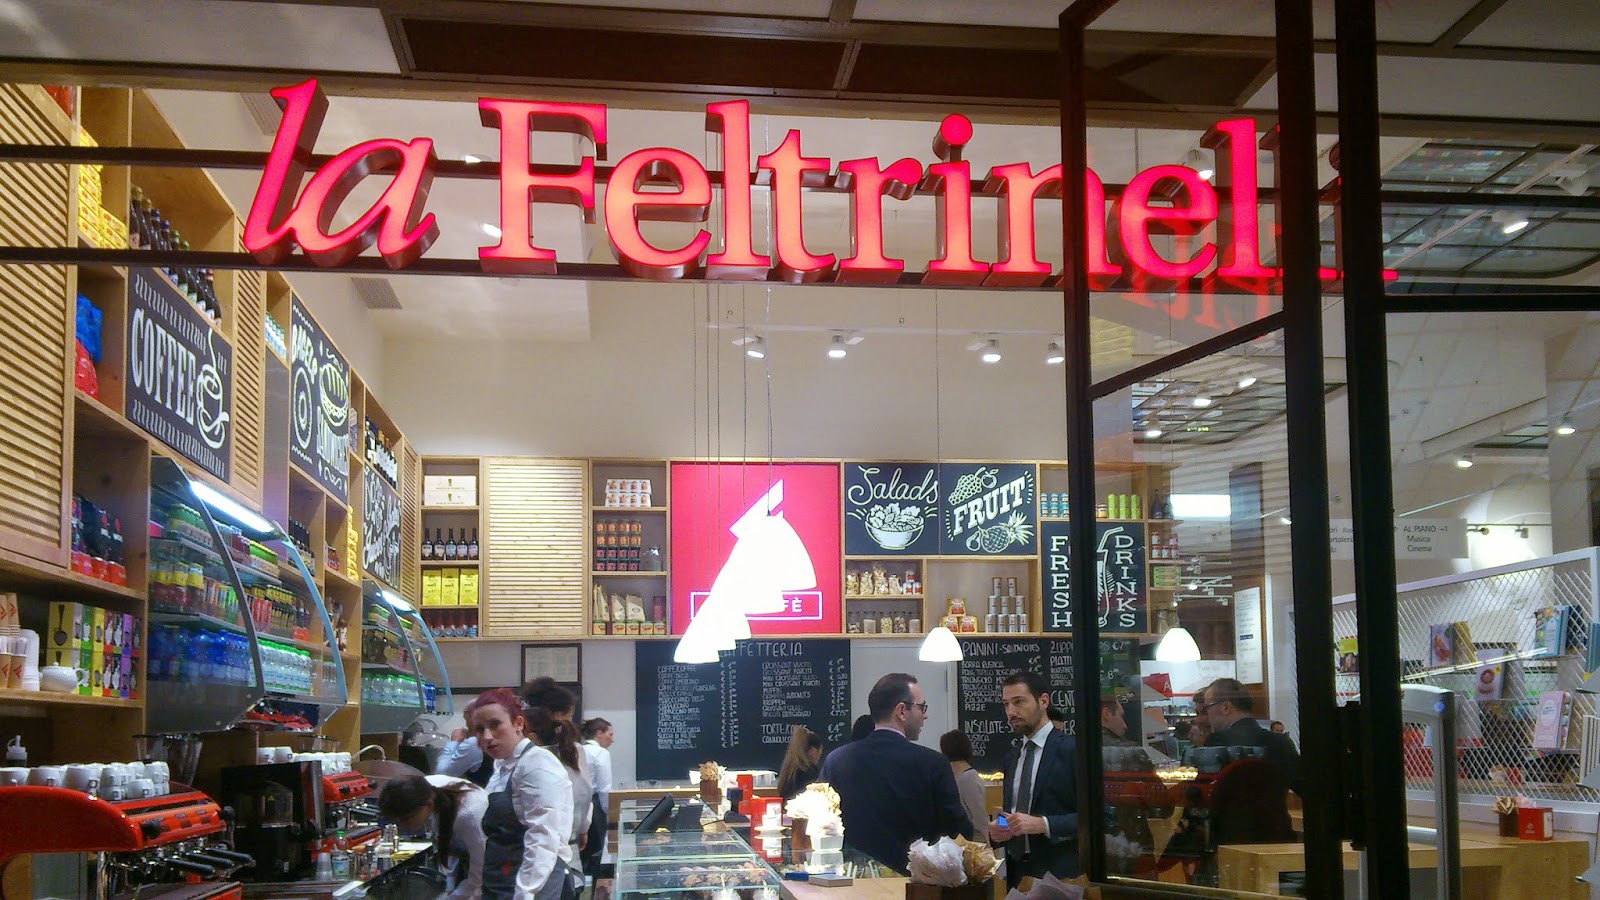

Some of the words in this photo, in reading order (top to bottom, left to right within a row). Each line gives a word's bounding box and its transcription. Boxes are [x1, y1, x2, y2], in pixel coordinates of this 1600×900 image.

[244, 78, 436, 256] la
[478, 97, 1397, 280] Feltrinel
[132, 308, 197, 426] COFFEE
[847, 465, 940, 505] Salads
[953, 476, 1027, 536] FRUIT
[1050, 535, 1073, 628] FRESH
[1114, 535, 1139, 628] DRINKS
[1407, 544, 1432, 552] Cinema
